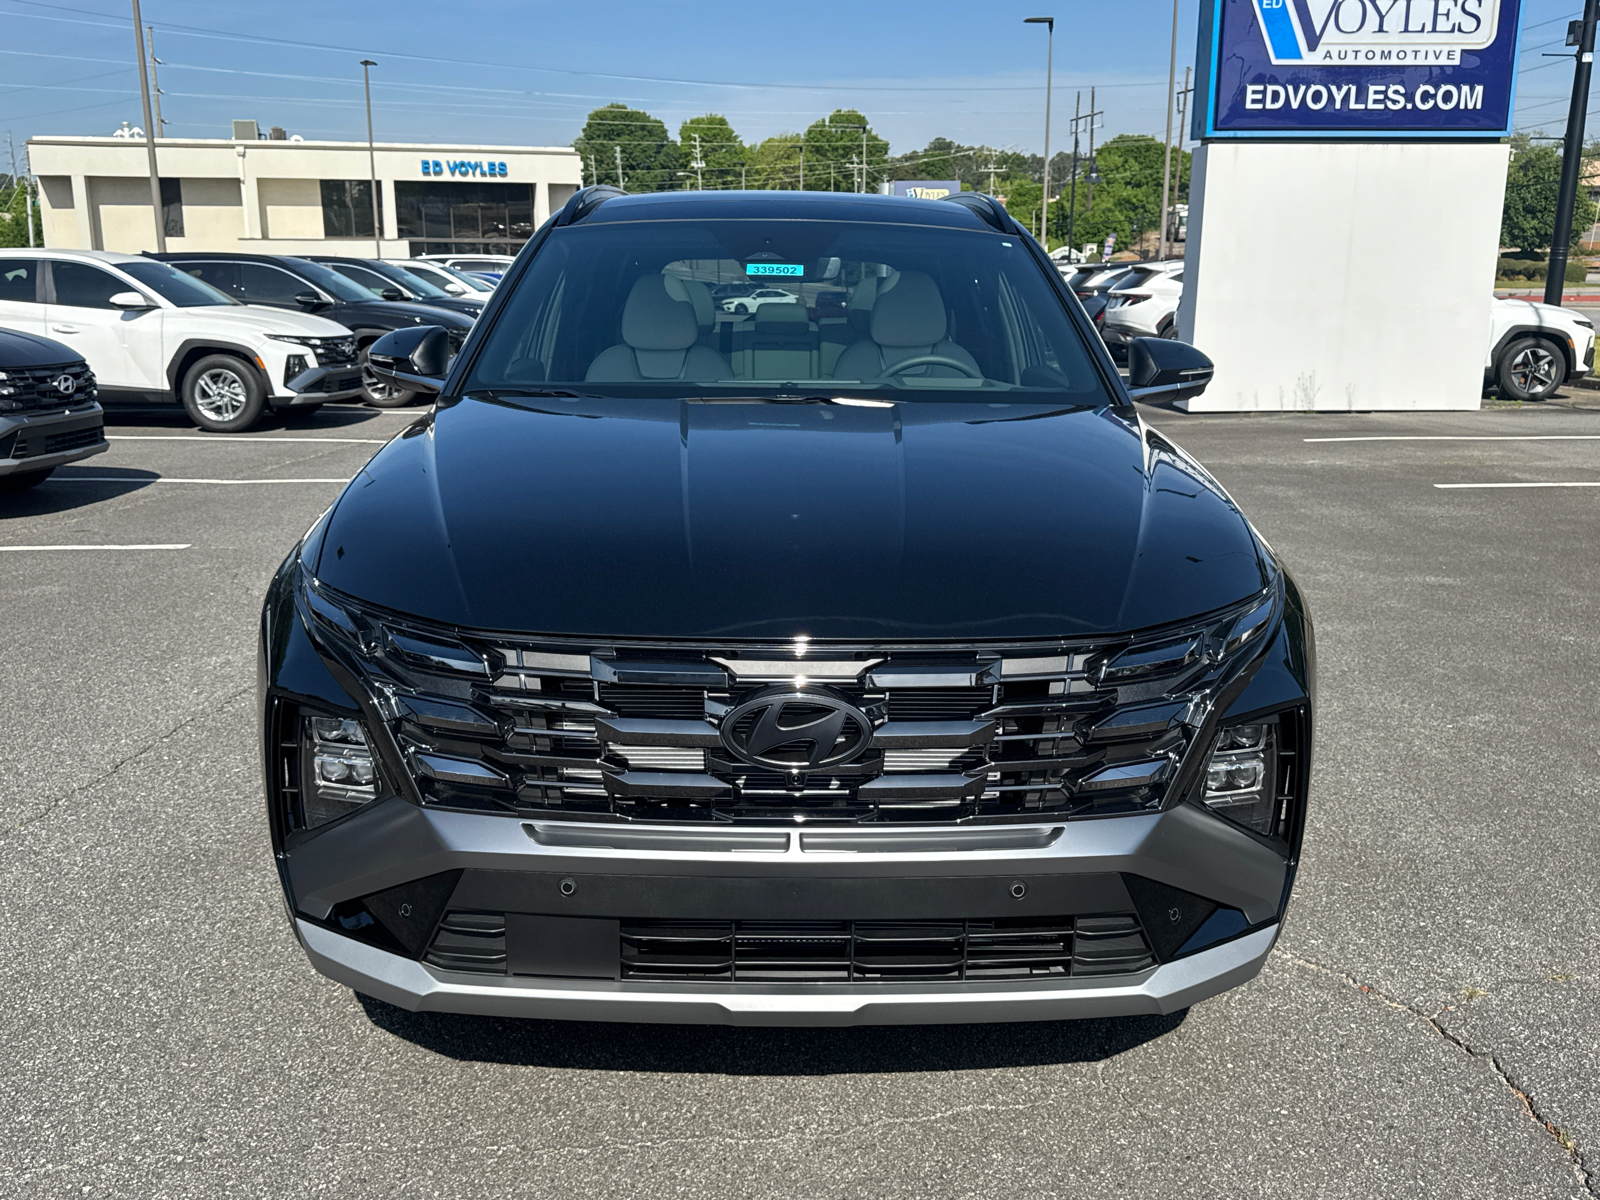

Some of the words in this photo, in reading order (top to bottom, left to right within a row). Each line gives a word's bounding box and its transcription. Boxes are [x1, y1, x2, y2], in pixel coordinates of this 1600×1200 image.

[1262, 0, 1283, 8] ED
[1291, 0, 1482, 51] VOYLES
[1322, 49, 1456, 61] AUTOMOTIVE
[1245, 83, 1484, 110] EDVOYLES.COM
[421, 159, 443, 175] ED
[446, 160, 508, 177] VOYLES
[752, 265, 798, 275] 339502
